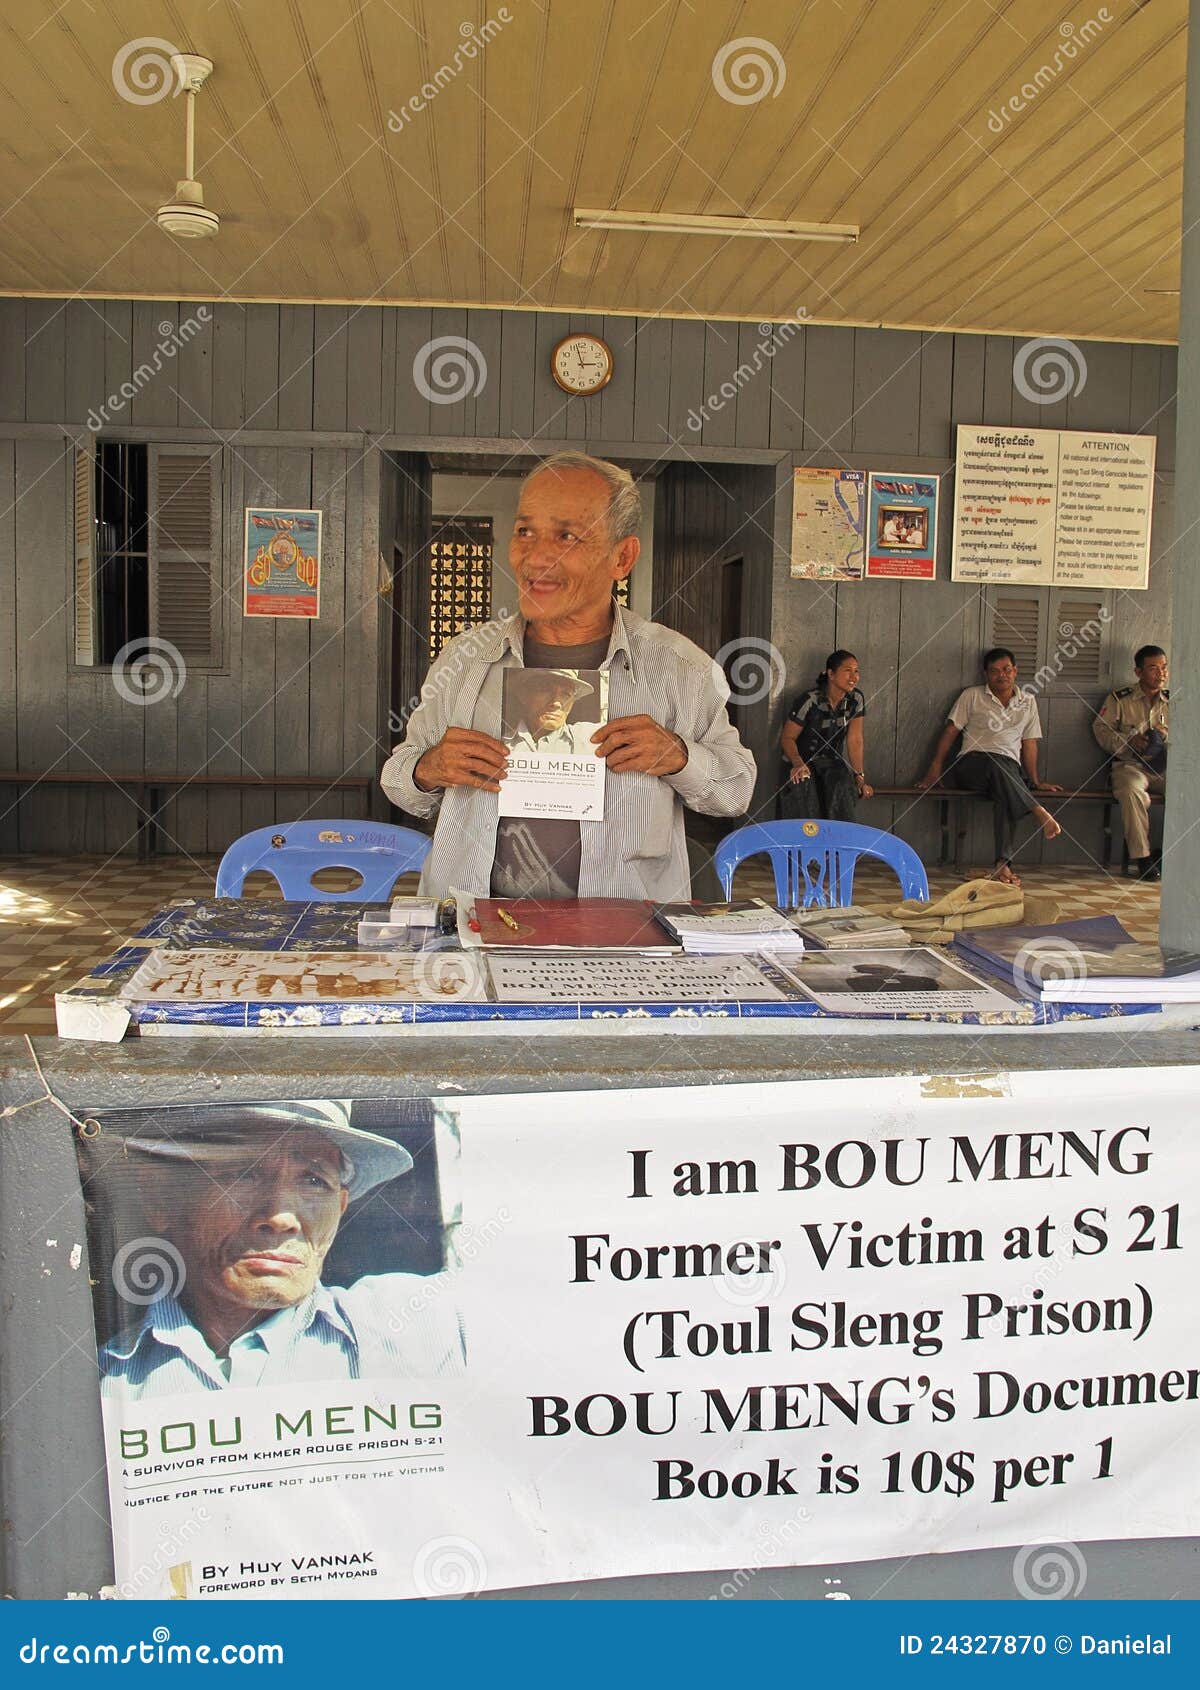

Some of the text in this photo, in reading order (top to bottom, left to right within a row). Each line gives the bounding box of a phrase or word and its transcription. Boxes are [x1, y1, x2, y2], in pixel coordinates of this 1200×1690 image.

[1082, 441, 1129, 451] ATTENTION
[548, 760, 596, 772] MENG
[626, 1126, 1153, 1200] I am BOU MENG
[568, 1202, 1183, 1284] Former Victim at S 21
[623, 1283, 1155, 1373] (Toul Sleng Prison)
[120, 1402, 443, 1460] BOU MENG
[526, 1391, 682, 1437] BOU
[700, 1375, 955, 1435] MENG's
[122, 1436, 444, 1478] A SURVIVOR FROM KHMER ROUGE PRISON S-21
[651, 1436, 1116, 1504] Book is 10$ per 1
[176, 1488, 198, 1500] FOR
[202, 1486, 225, 1496] THE
[230, 1480, 274, 1493] FUTURE
[279, 1478, 304, 1487] NOT
[309, 1474, 340, 1484] JUST
[345, 1472, 367, 1480] FOR
[372, 1470, 394, 1478] THE
[399, 1465, 445, 1476] VICTIMS
[200, 1568, 378, 1594] FOREWORD BY SETH MYDANS
[240, 1558, 283, 1575] HUY
[292, 1552, 374, 1570] VANNAK
